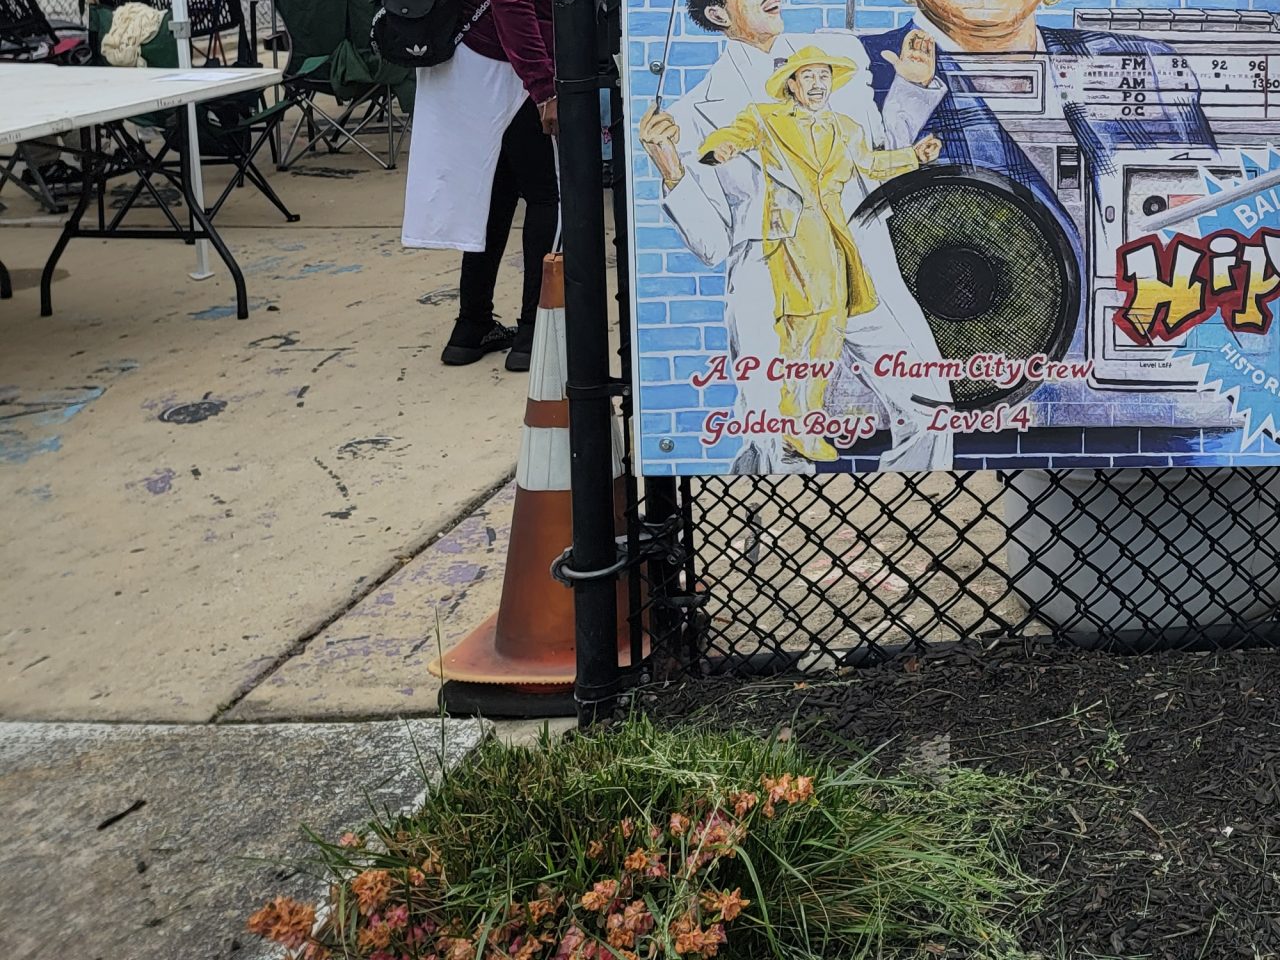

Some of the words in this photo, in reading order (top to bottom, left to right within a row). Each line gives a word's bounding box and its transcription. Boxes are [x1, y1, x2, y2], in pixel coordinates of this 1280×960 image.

[1121, 58, 1146, 70] FM
[1172, 58, 1188, 69] 88
[1211, 60, 1228, 70] 92
[1248, 60, 1266, 72] 96
[1118, 77, 1146, 89] AM
[1122, 91, 1146, 103] PO
[1121, 106, 1145, 117] OC
[766, 357, 834, 381] Crew
[874, 350, 963, 379] Charm
[968, 353, 1023, 386] City
[1027, 356, 1093, 380] Crew
[701, 411, 799, 445] Golden
[804, 412, 876, 446] Boys
[927, 404, 1004, 432] Level
[1010, 406, 1031, 430] 4
